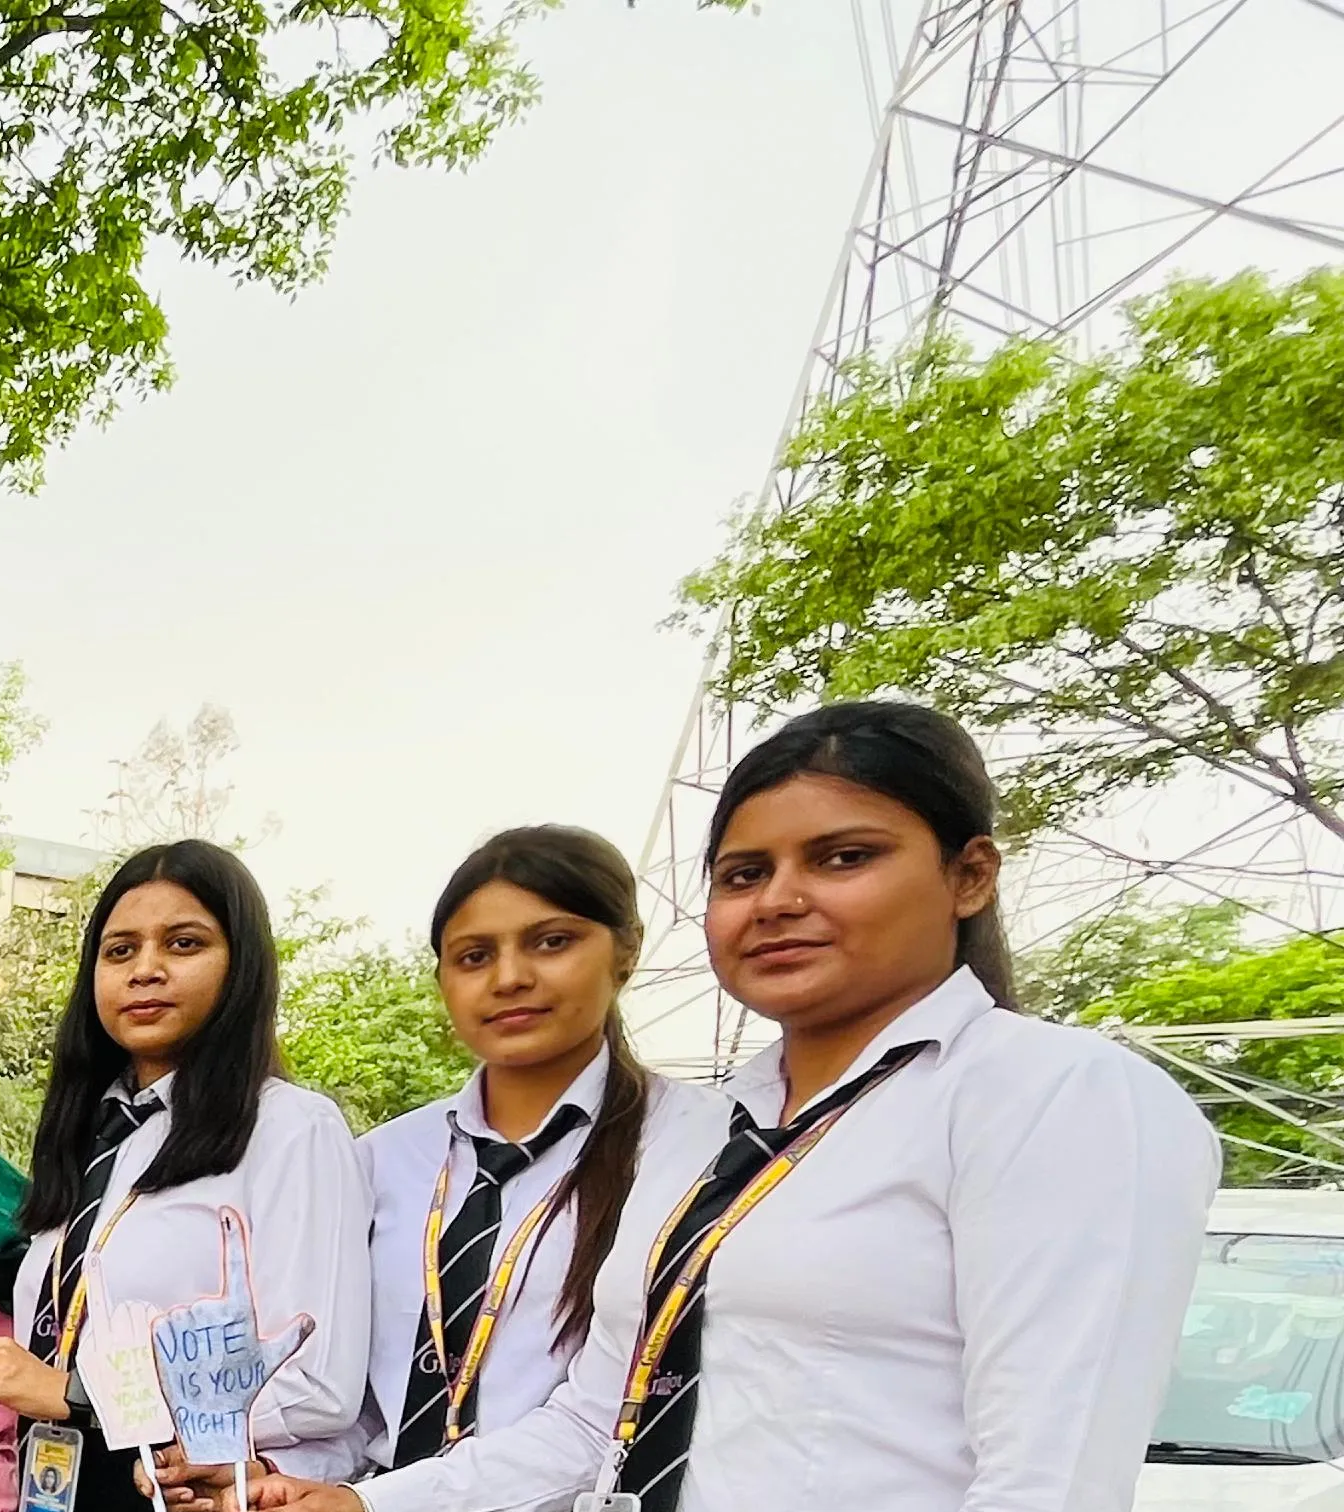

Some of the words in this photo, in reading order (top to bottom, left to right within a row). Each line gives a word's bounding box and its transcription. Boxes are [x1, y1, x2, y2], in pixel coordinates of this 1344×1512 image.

[155, 1319, 248, 1364] VOTE
[178, 1372, 201, 1398] IS
[210, 1360, 266, 1394] YOUR
[174, 1405, 248, 1442] RIGHT
